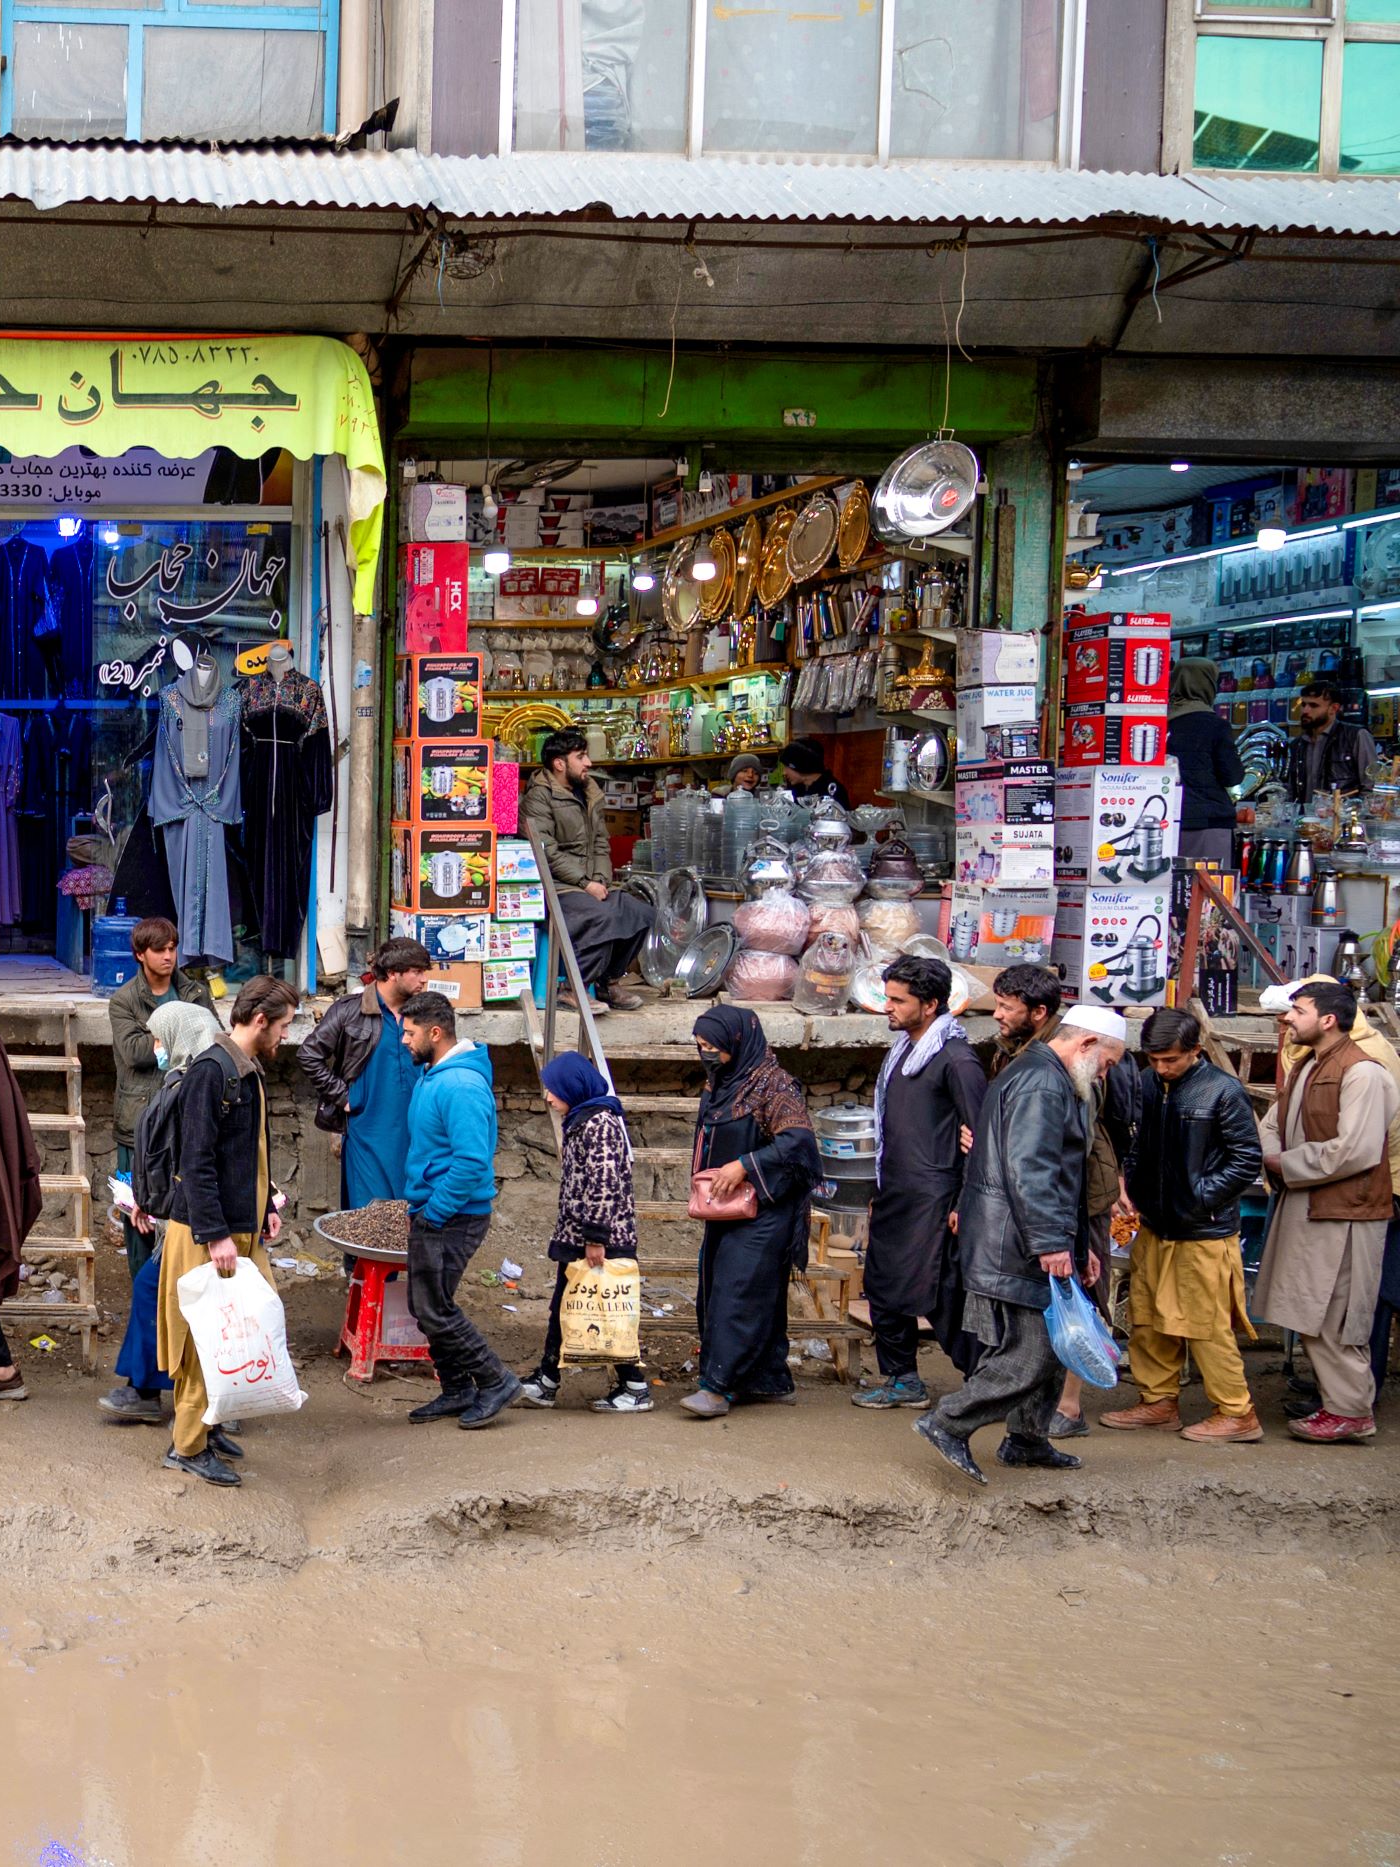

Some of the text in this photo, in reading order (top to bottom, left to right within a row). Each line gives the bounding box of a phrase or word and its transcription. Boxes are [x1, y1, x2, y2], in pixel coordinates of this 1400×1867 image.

[57, 347, 301, 433] جهان
[10, 460, 53, 478] حجاب
[59, 463, 107, 479] بهترین
[113, 462, 152, 477] کننده
[157, 463, 196, 480] عرضه
[106, 543, 286, 629] جهان حجاب
[986, 688, 1033, 697] WATER JUG
[1127, 694, 1152, 702] S-LAYERS
[957, 770, 978, 780] MASTER
[1010, 765, 1048, 775] MASTER
[1101, 771, 1139, 784] Sonifer
[1013, 830, 1043, 839] SUJATA
[1091, 892, 1132, 905] Sonifer
[586, 1301, 633, 1312] GALLERY
